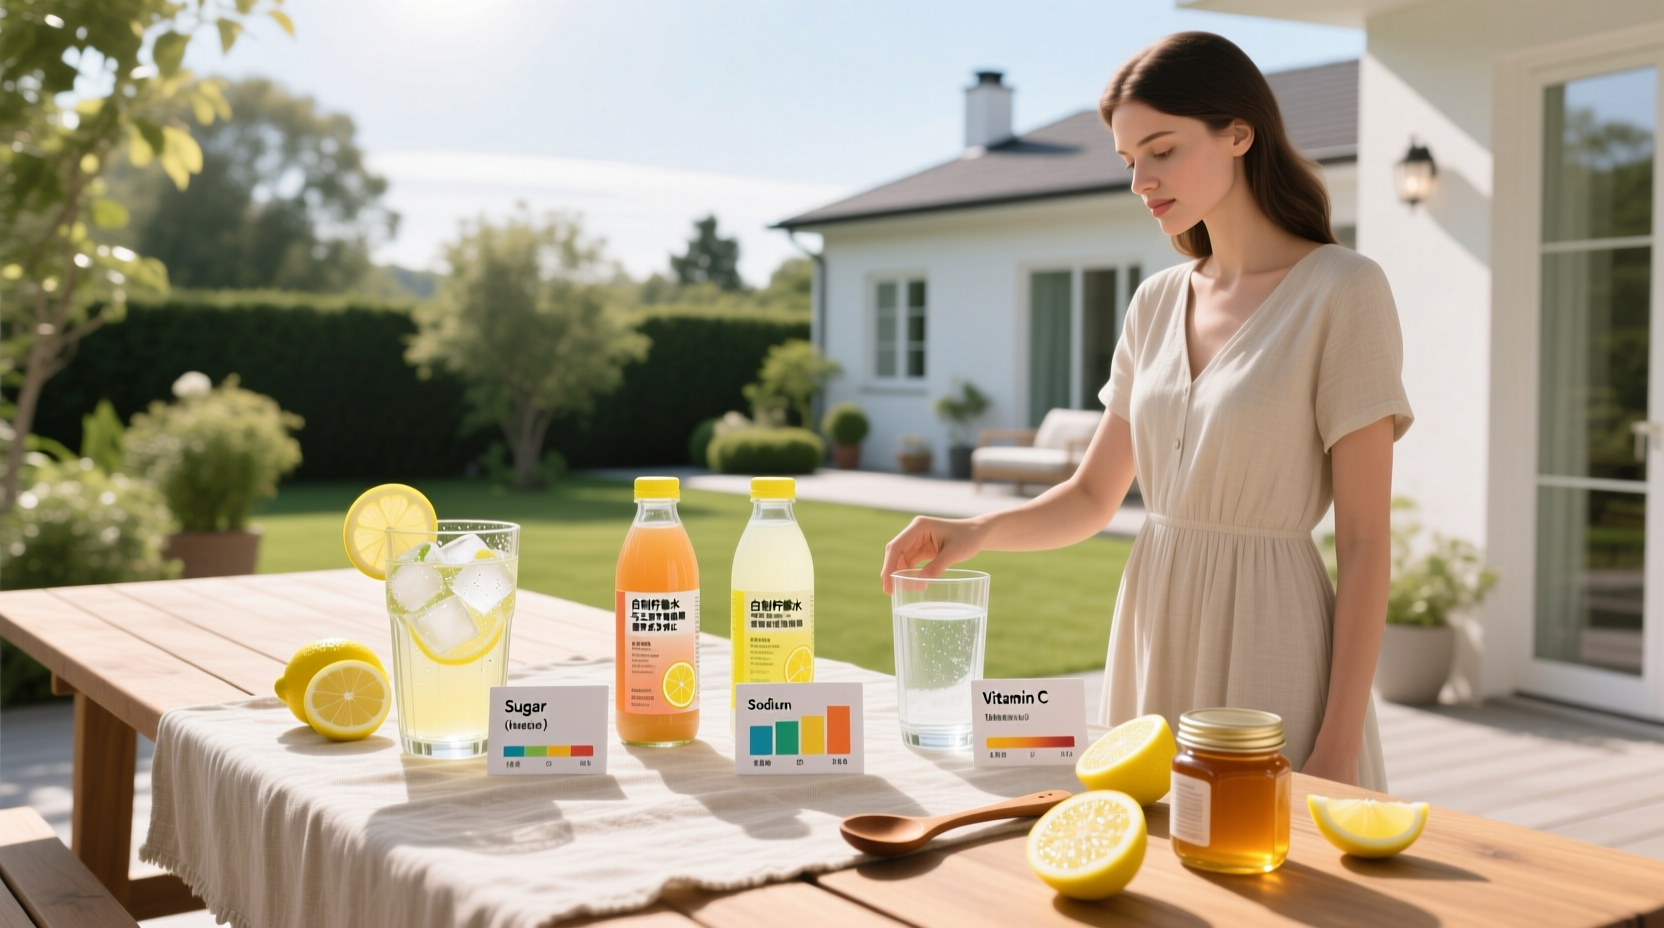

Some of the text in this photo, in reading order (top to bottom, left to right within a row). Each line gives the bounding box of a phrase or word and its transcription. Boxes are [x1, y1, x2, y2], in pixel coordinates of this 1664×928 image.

[982, 690, 1049, 705] Vitamin C
[504, 699, 547, 717] Sugar
